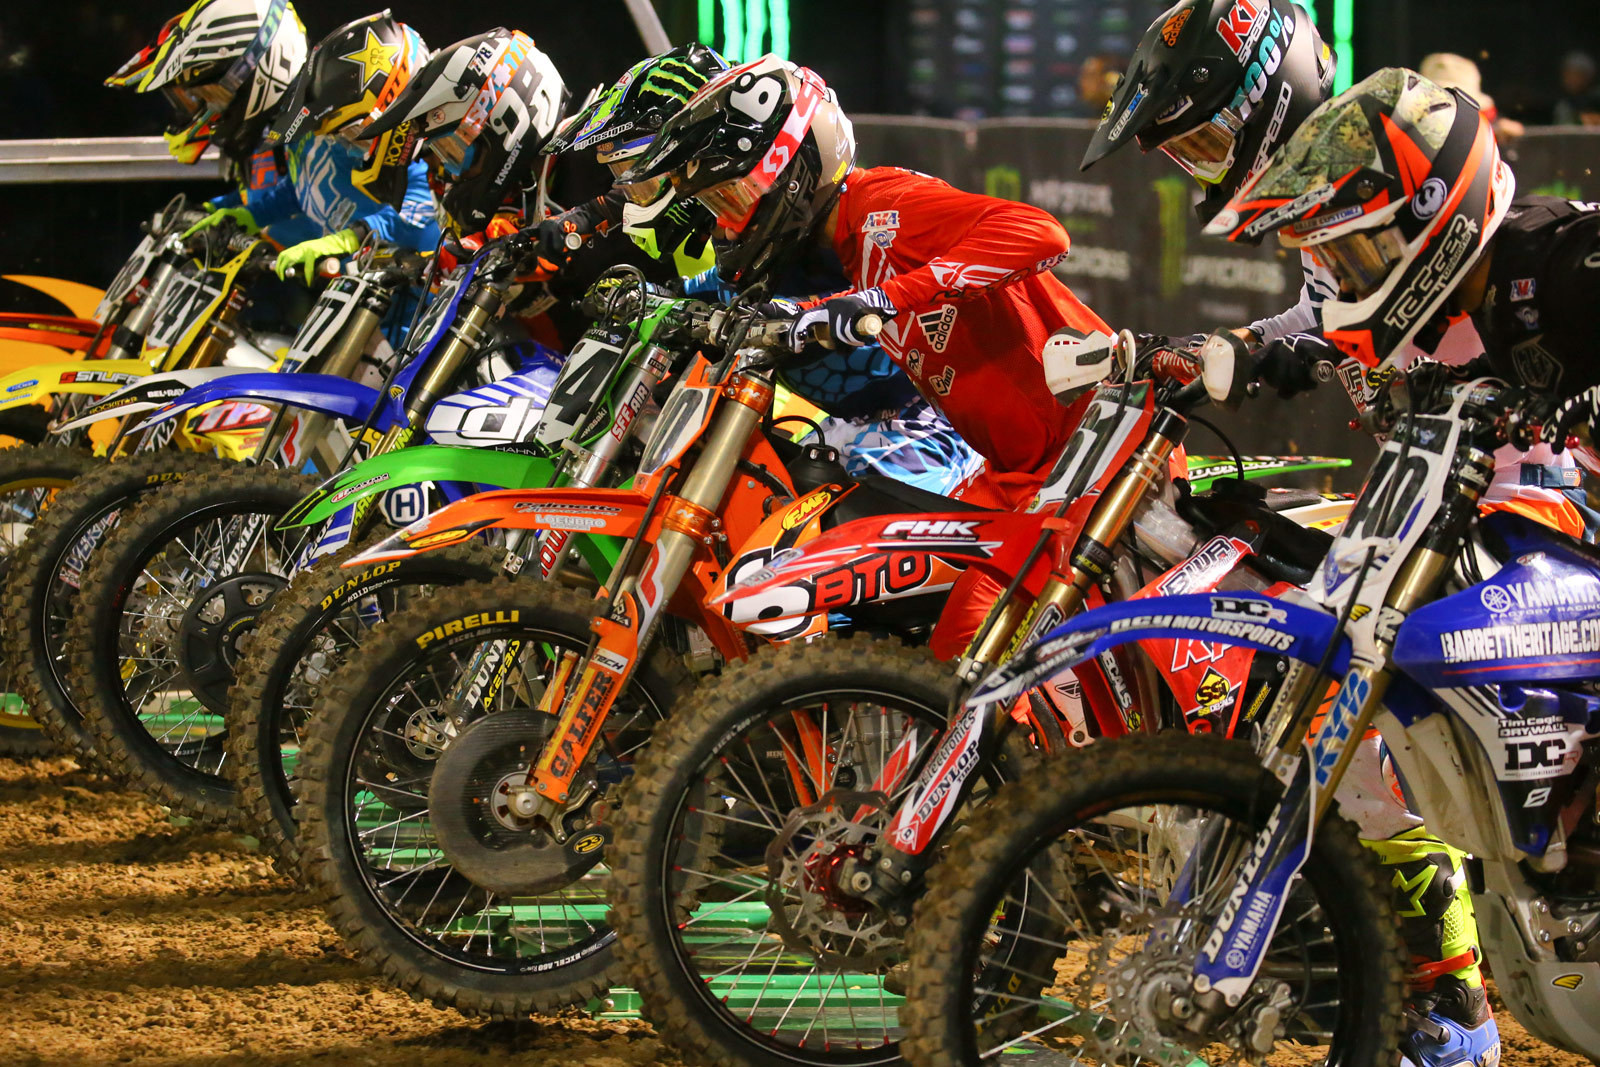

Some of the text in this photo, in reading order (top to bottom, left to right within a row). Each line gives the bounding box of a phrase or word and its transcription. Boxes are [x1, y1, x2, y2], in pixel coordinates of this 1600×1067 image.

[1216, 0, 1260, 56] K1
[1238, 6, 1271, 67] SPEED
[1230, 8, 1295, 121] 100%
[466, 78, 499, 126] SPY
[864, 211, 900, 231] AMA
[933, 305, 956, 351] adidas
[551, 347, 622, 426] 4
[631, 381, 649, 416] AIR
[580, 408, 607, 438] wasaki
[611, 402, 635, 443] SFF
[495, 445, 537, 457] HAHN
[146, 472, 188, 485] DUN
[535, 514, 607, 528] LOENBRO
[784, 492, 831, 529] FMF
[881, 520, 976, 536] FHK
[320, 560, 401, 611] DUNLOP
[814, 553, 932, 611] BTO
[1507, 577, 1600, 608] YAMAHA
[415, 609, 520, 649] PIRELLI
[1171, 615, 1295, 651] MOTORSPORTS
[1490, 608, 1551, 620] FACTORY
[1440, 618, 1600, 665] BARRETTHERITAGE.CO
[464, 639, 508, 709] DUNL
[550, 670, 613, 778] GALFER
[1314, 667, 1374, 788] KYB
[1499, 723, 1567, 737] DRYWALL
[1500, 714, 1564, 728] Tim Cagle
[916, 739, 979, 824] DUNLOP
[1201, 801, 1283, 965] DUNLOP
[1233, 890, 1273, 951] YAMAHA
